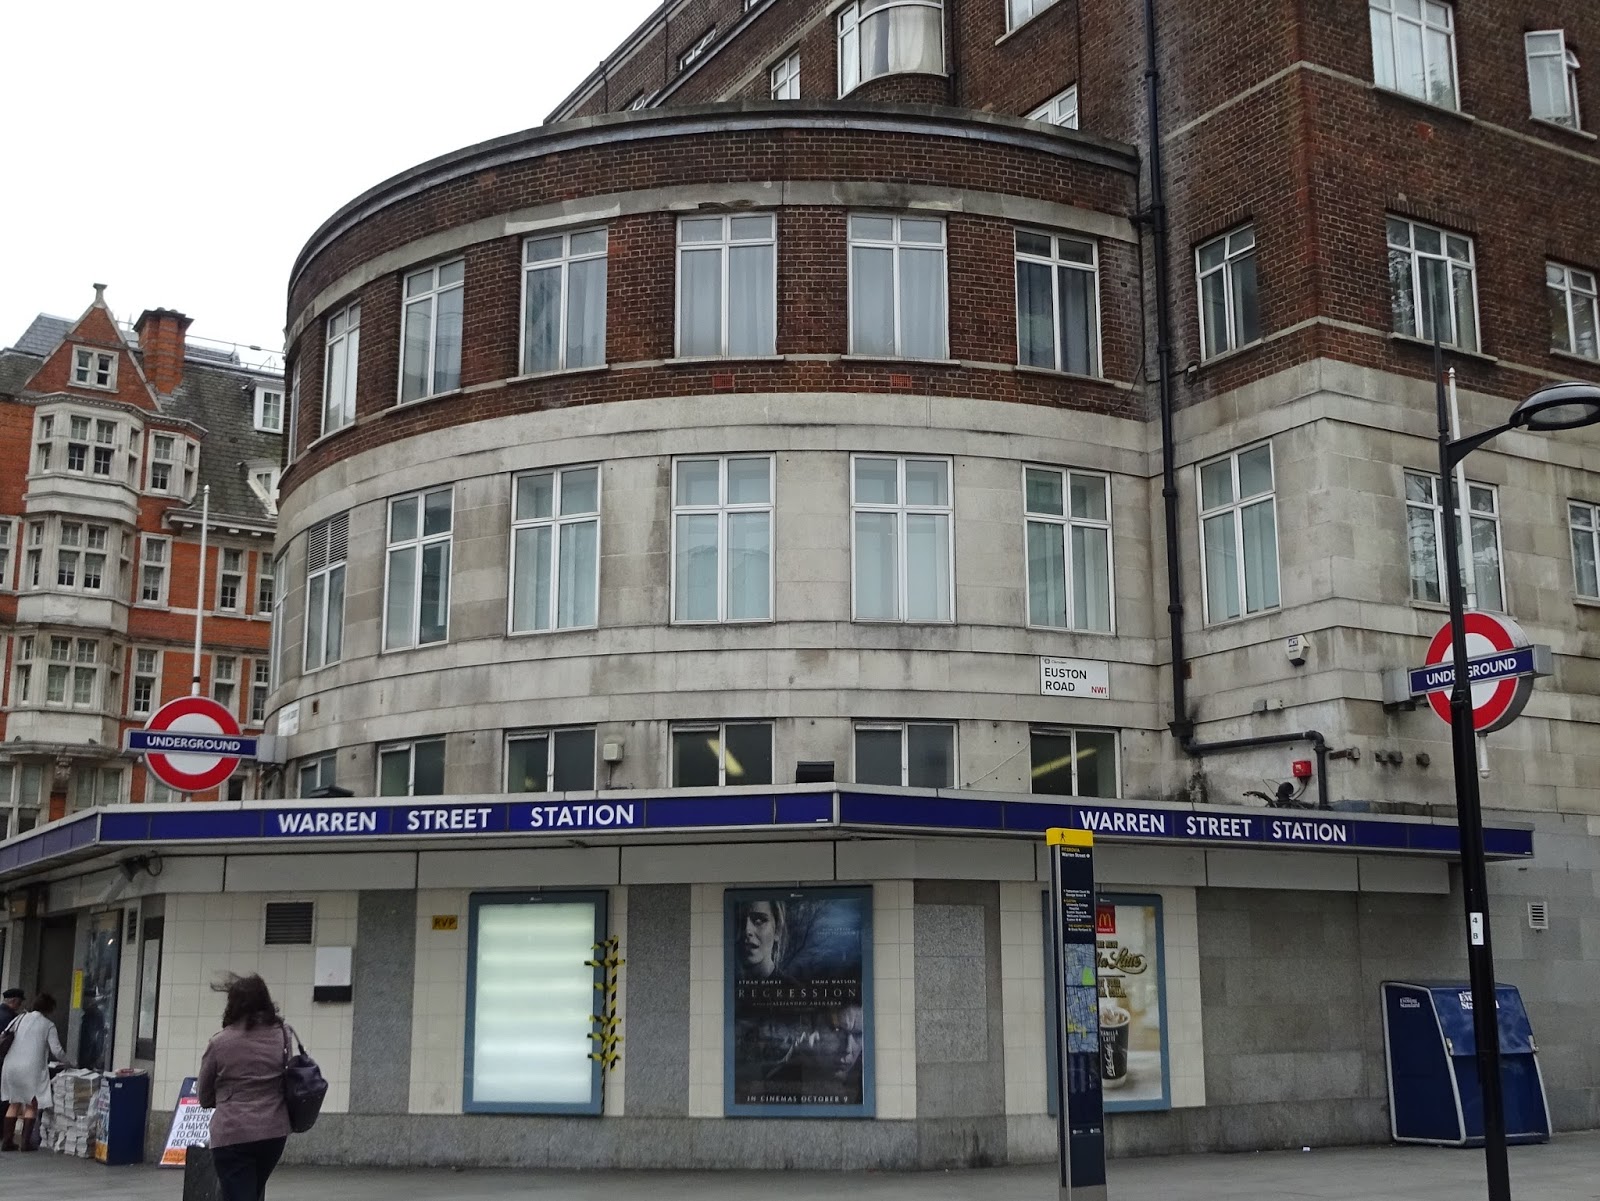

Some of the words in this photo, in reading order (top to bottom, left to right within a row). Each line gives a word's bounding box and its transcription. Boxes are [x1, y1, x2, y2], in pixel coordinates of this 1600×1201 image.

[1044, 667, 1087, 680] EUSTON
[1426, 657, 1517, 685] UNDEGROUND
[1045, 680, 1076, 692] ROAD
[1091, 686, 1107, 694] NW1
[146, 735, 241, 751] UNDERGROUND
[278, 811, 377, 833] WARREN
[406, 808, 492, 831] STREET
[530, 804, 635, 827] STATION
[1079, 810, 1165, 833] WARREN
[1186, 816, 1252, 838] STREET
[1272, 820, 1347, 842] STATION
[434, 917, 457, 927] RVP
[738, 988, 857, 998] REGRESSION
[183, 1114, 210, 1122] OFFERS
[185, 1122, 209, 1130] HAVEN
